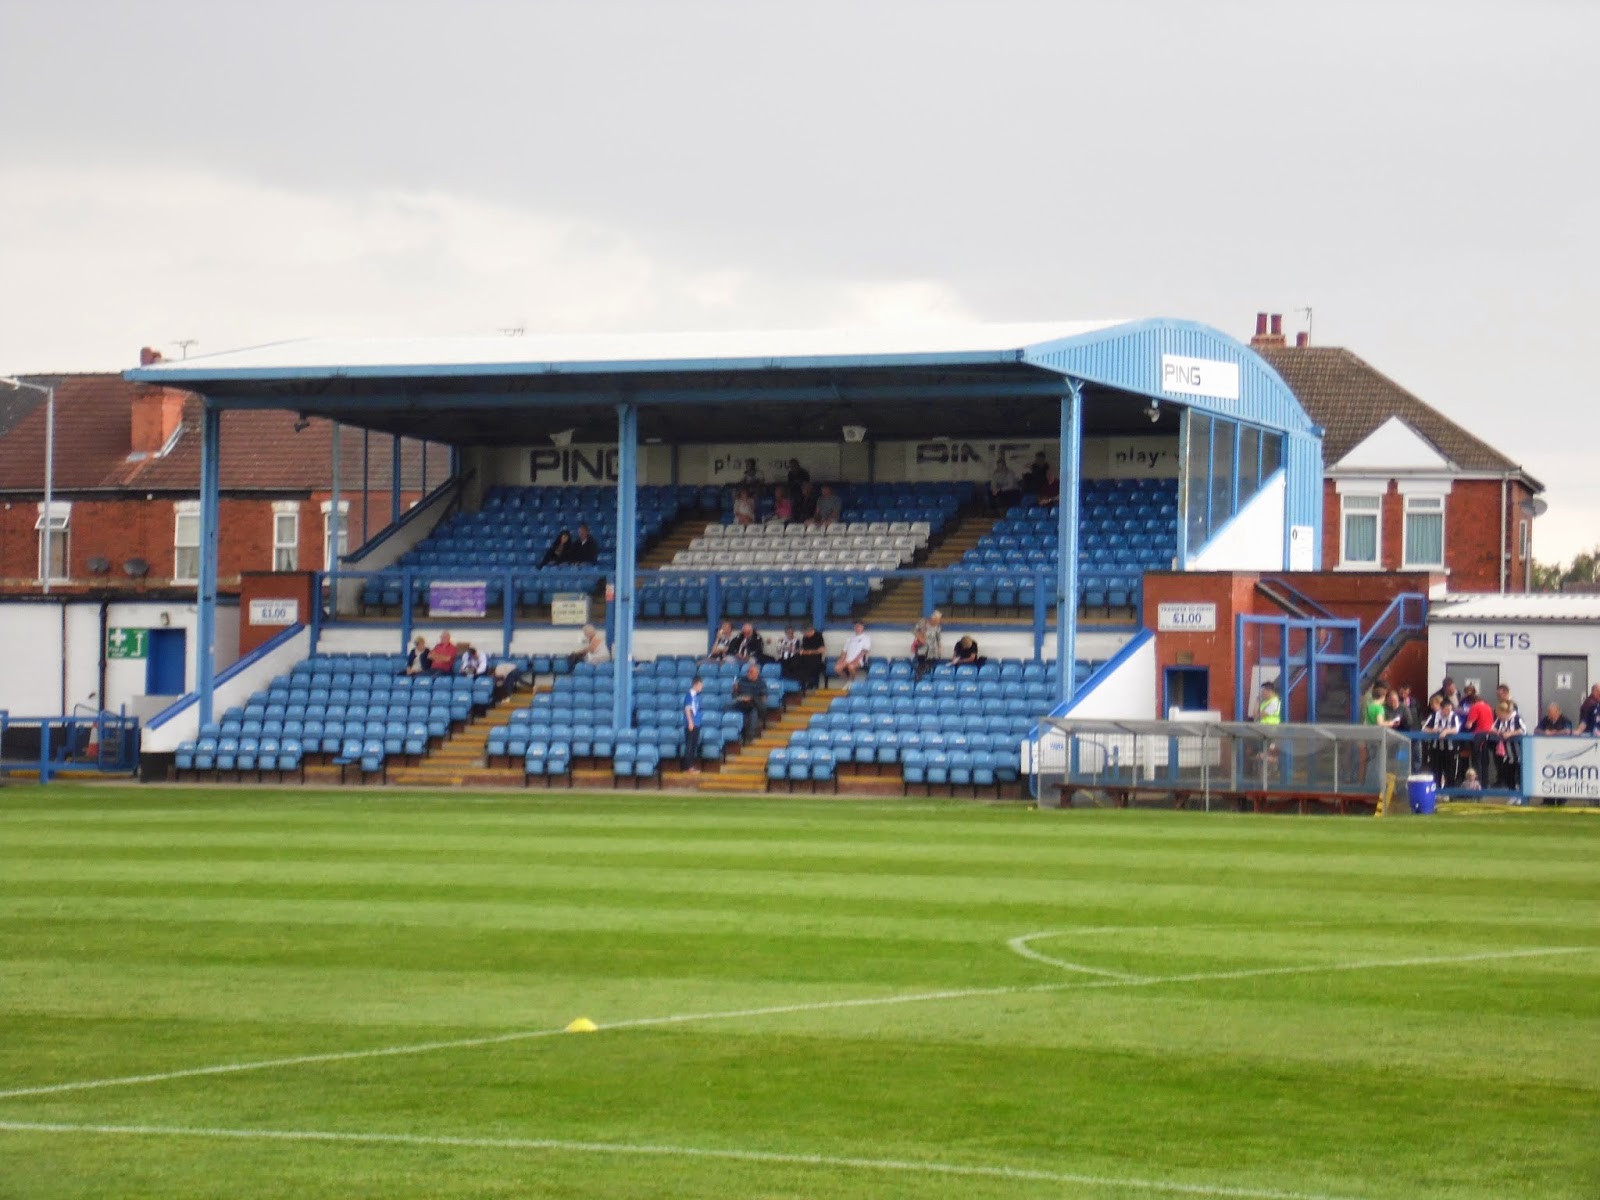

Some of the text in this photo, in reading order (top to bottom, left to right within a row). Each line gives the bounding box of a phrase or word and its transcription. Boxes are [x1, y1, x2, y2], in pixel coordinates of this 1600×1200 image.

[1164, 363, 1201, 386] PING
[262, 608, 286, 619] £1.00
[1173, 613, 1202, 624] £1.00
[1452, 631, 1531, 650] TOILETS
[1541, 764, 1599, 780] OBAM
[1541, 780, 1599, 795] Stairlifts
